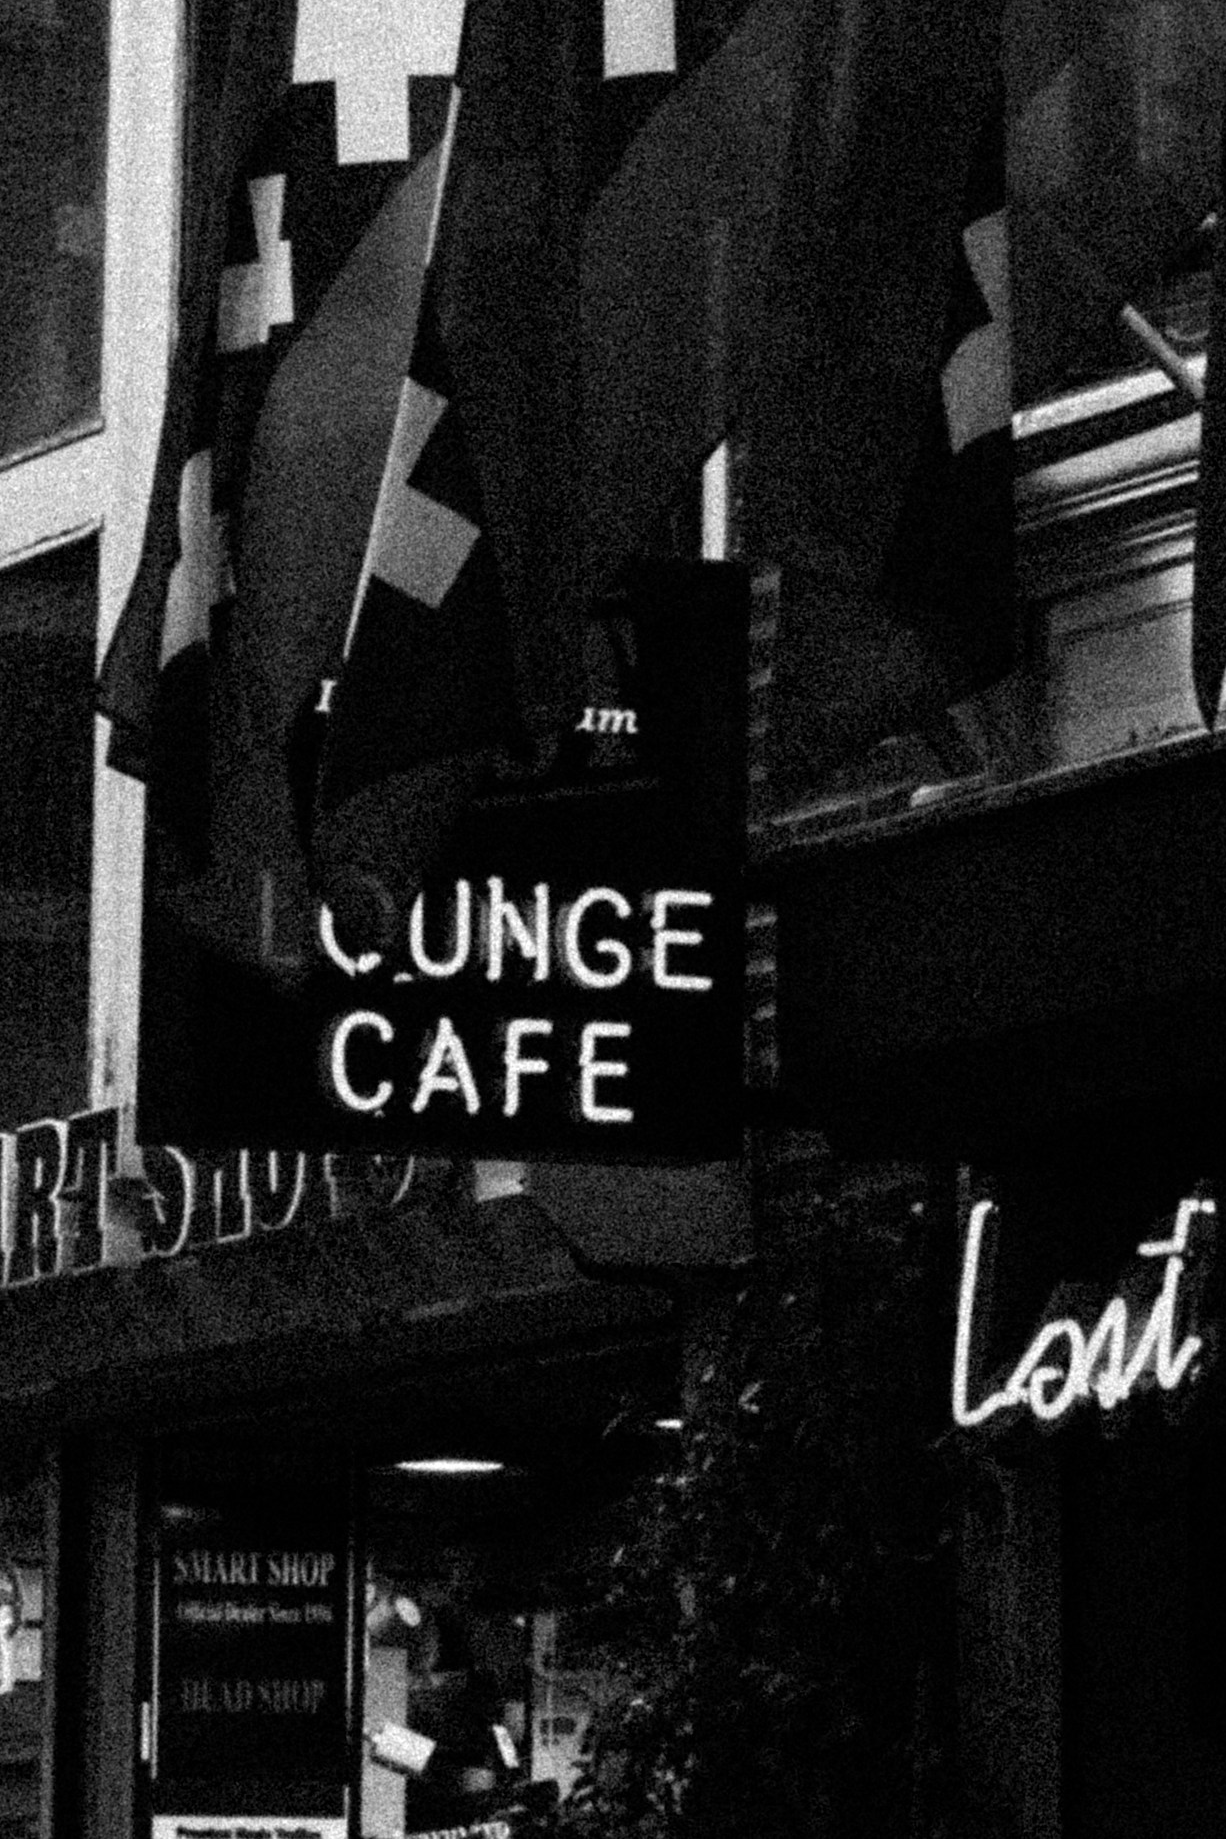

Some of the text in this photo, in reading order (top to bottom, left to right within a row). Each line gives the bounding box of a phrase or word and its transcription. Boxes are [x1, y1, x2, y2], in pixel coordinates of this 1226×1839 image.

[262, 870, 712, 991] OUNGE
[330, 1010, 634, 1122] CAFE
[953, 1198, 1216, 1426] Lost
[173, 1551, 336, 1588] SMART SHOP
